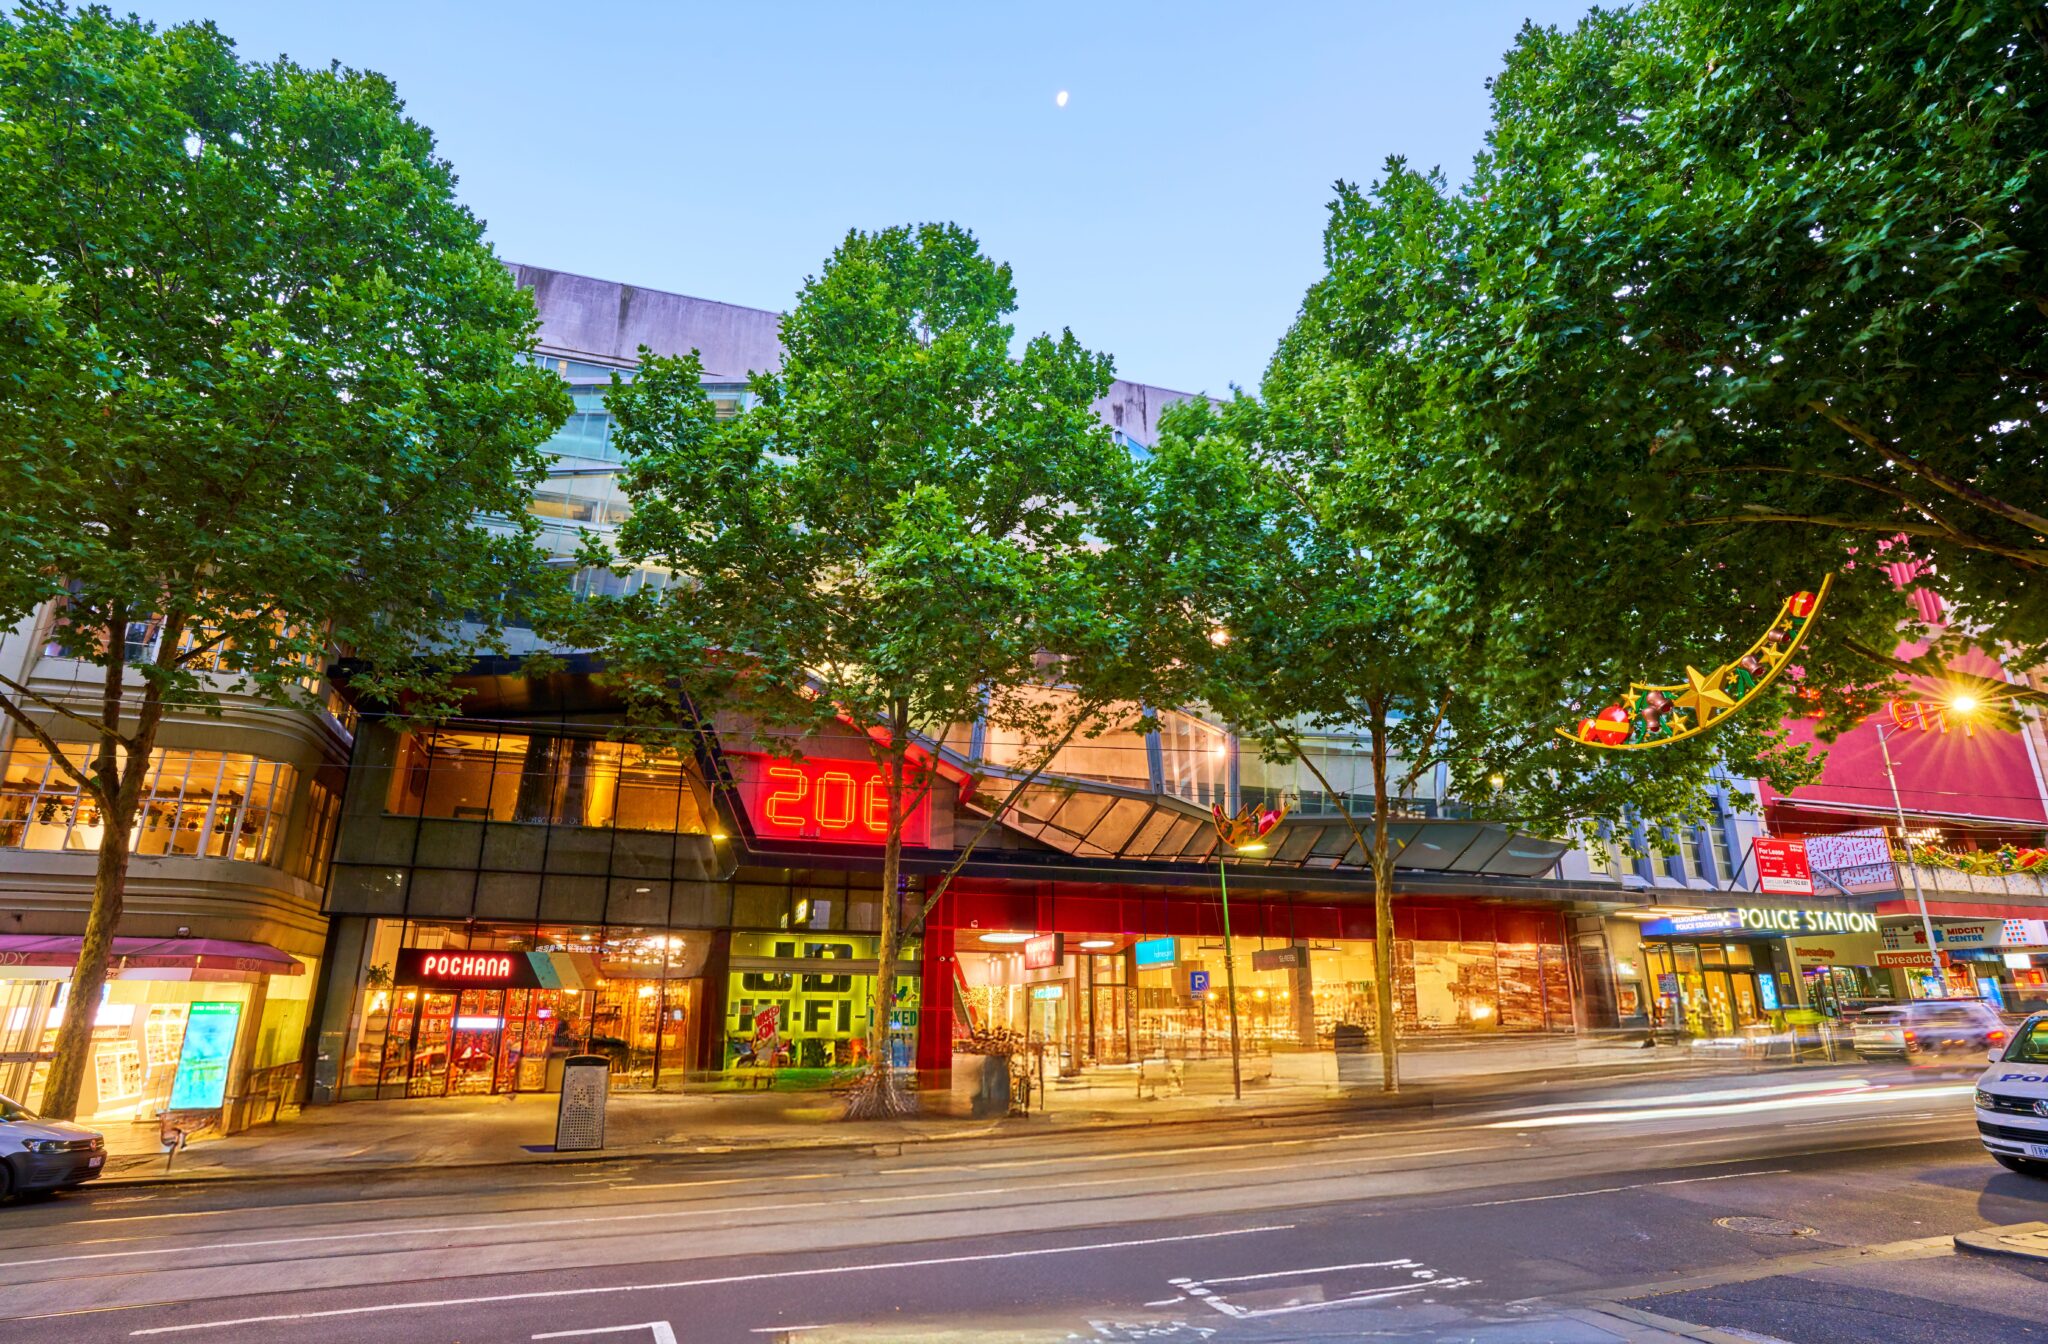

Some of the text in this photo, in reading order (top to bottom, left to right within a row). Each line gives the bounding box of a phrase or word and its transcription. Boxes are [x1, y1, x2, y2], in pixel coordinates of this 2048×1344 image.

[1738, 907, 1878, 933] POLICE STATION
[1946, 927, 1985, 936] MIDCITY
[1948, 934, 1984, 944] CENTRE
[424, 956, 511, 977] POCHANA
[1195, 975, 1205, 988] P
